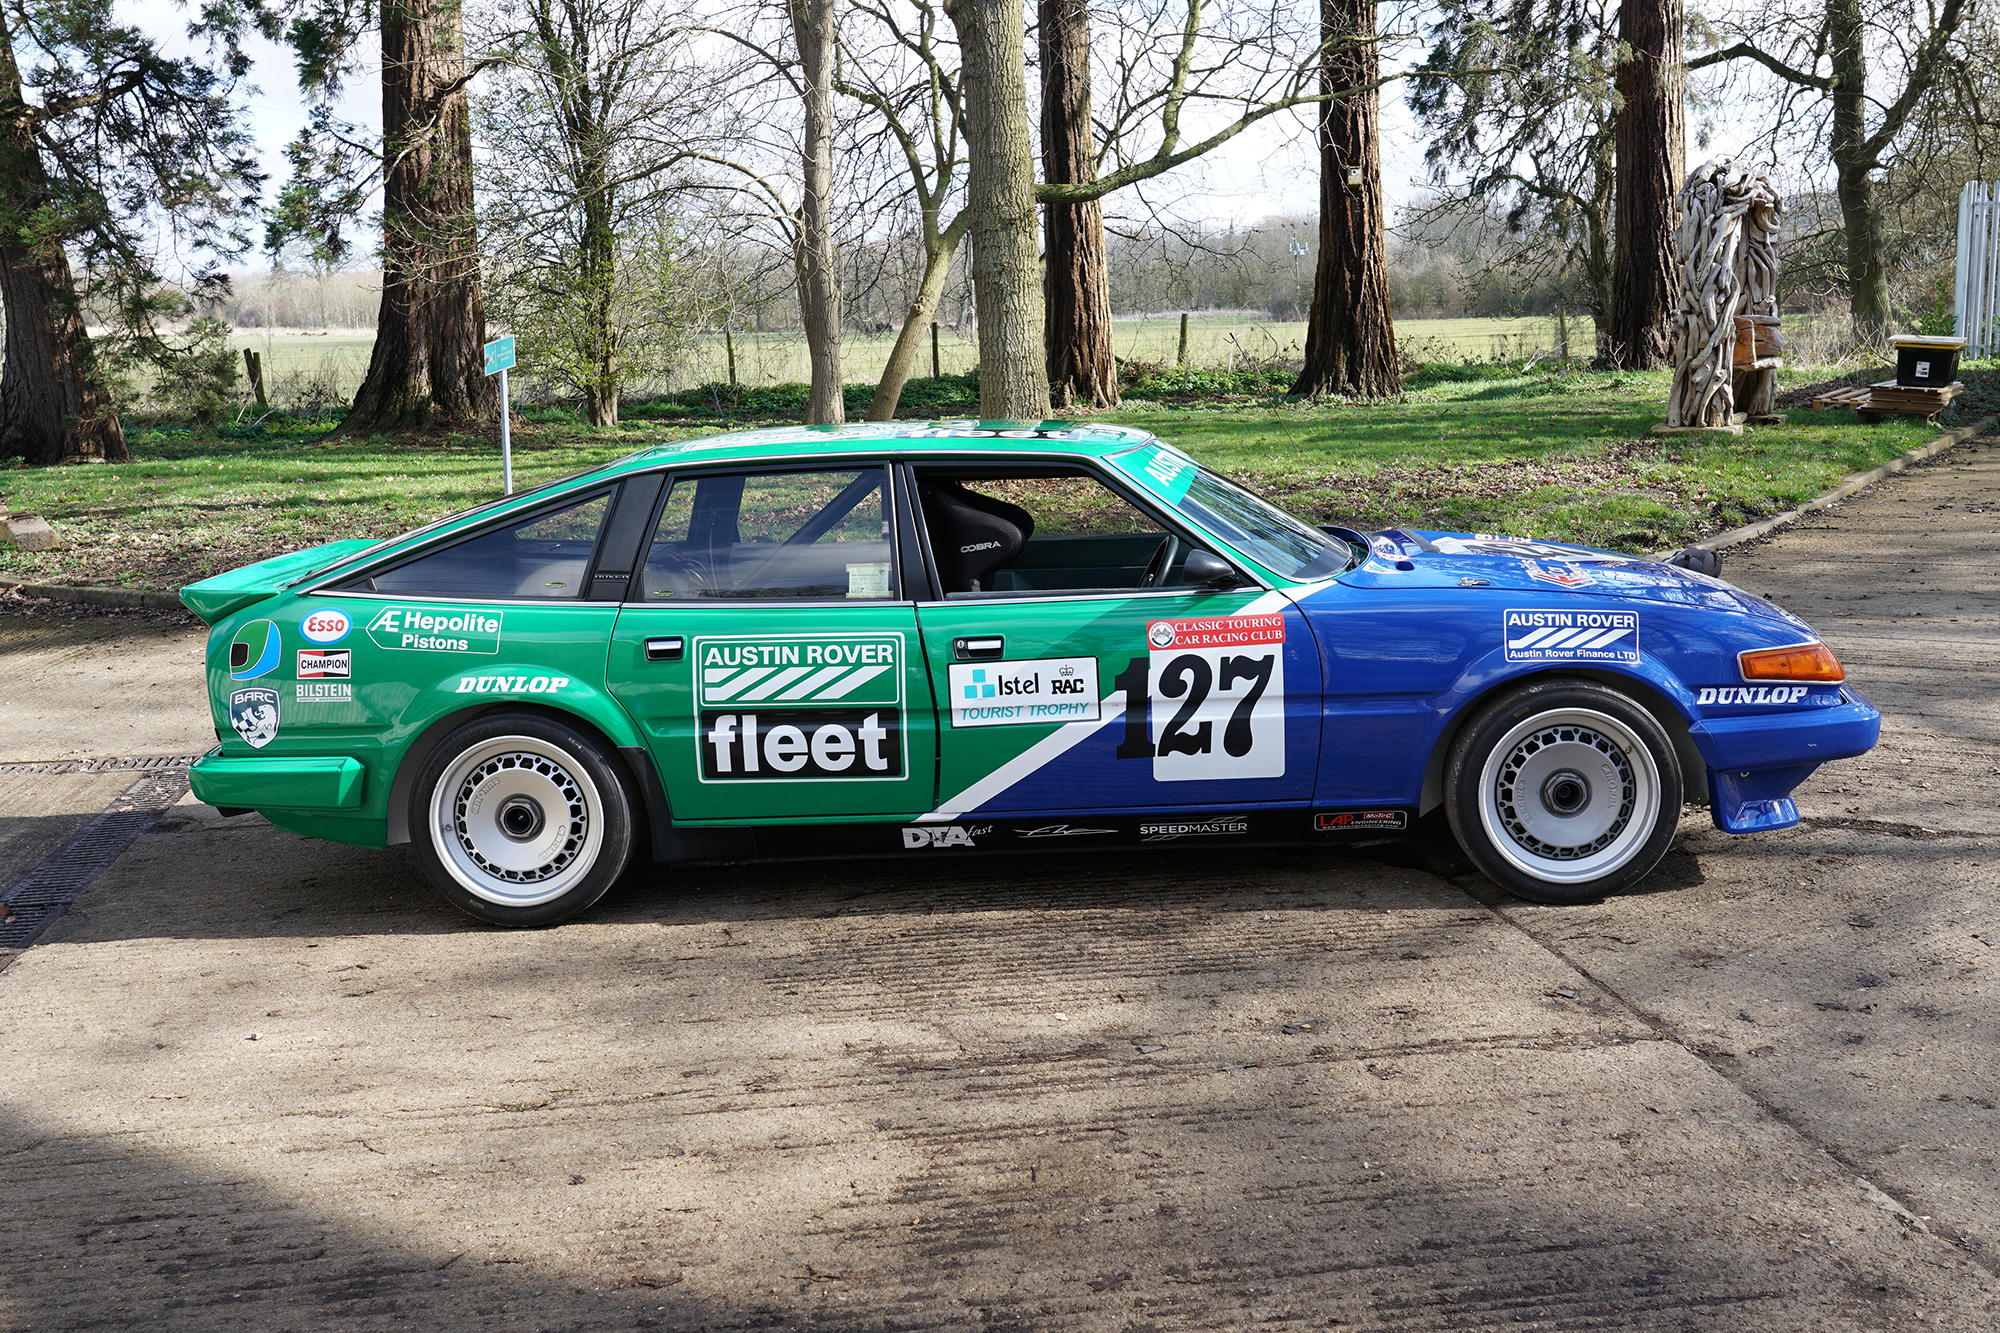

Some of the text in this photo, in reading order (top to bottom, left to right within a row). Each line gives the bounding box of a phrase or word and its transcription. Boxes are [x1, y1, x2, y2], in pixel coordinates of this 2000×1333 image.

[960, 540, 1001, 553] COBRA
[403, 611, 499, 634] Hepolite
[1174, 621, 1224, 632] CLASSIC
[1226, 617, 1282, 629] TOURING
[1508, 613, 1635, 628] AUSTIN ROVER
[401, 633, 469, 651] Pistons
[1175, 630, 1283, 645] CAR RACING CLUB
[704, 644, 894, 666] AUSTIN ROVER
[1509, 649, 1636, 660] Austin Rover Finance LTD
[301, 659, 348, 669] CHAMPION
[296, 684, 352, 697] BILSTEIN
[455, 676, 569, 694] DUNLOP
[998, 672, 1085, 696] Istel RAC
[234, 691, 275, 705] BARC
[1696, 686, 1808, 705] DUNLOP
[960, 702, 1090, 720] TOURIST TROPHY
[1114, 653, 1276, 760] 127
[708, 711, 889, 773] fleet
[1320, 814, 1355, 826] LAP
[967, 824, 994, 837] fast
[1140, 822, 1248, 834] SPEEDMASTER
